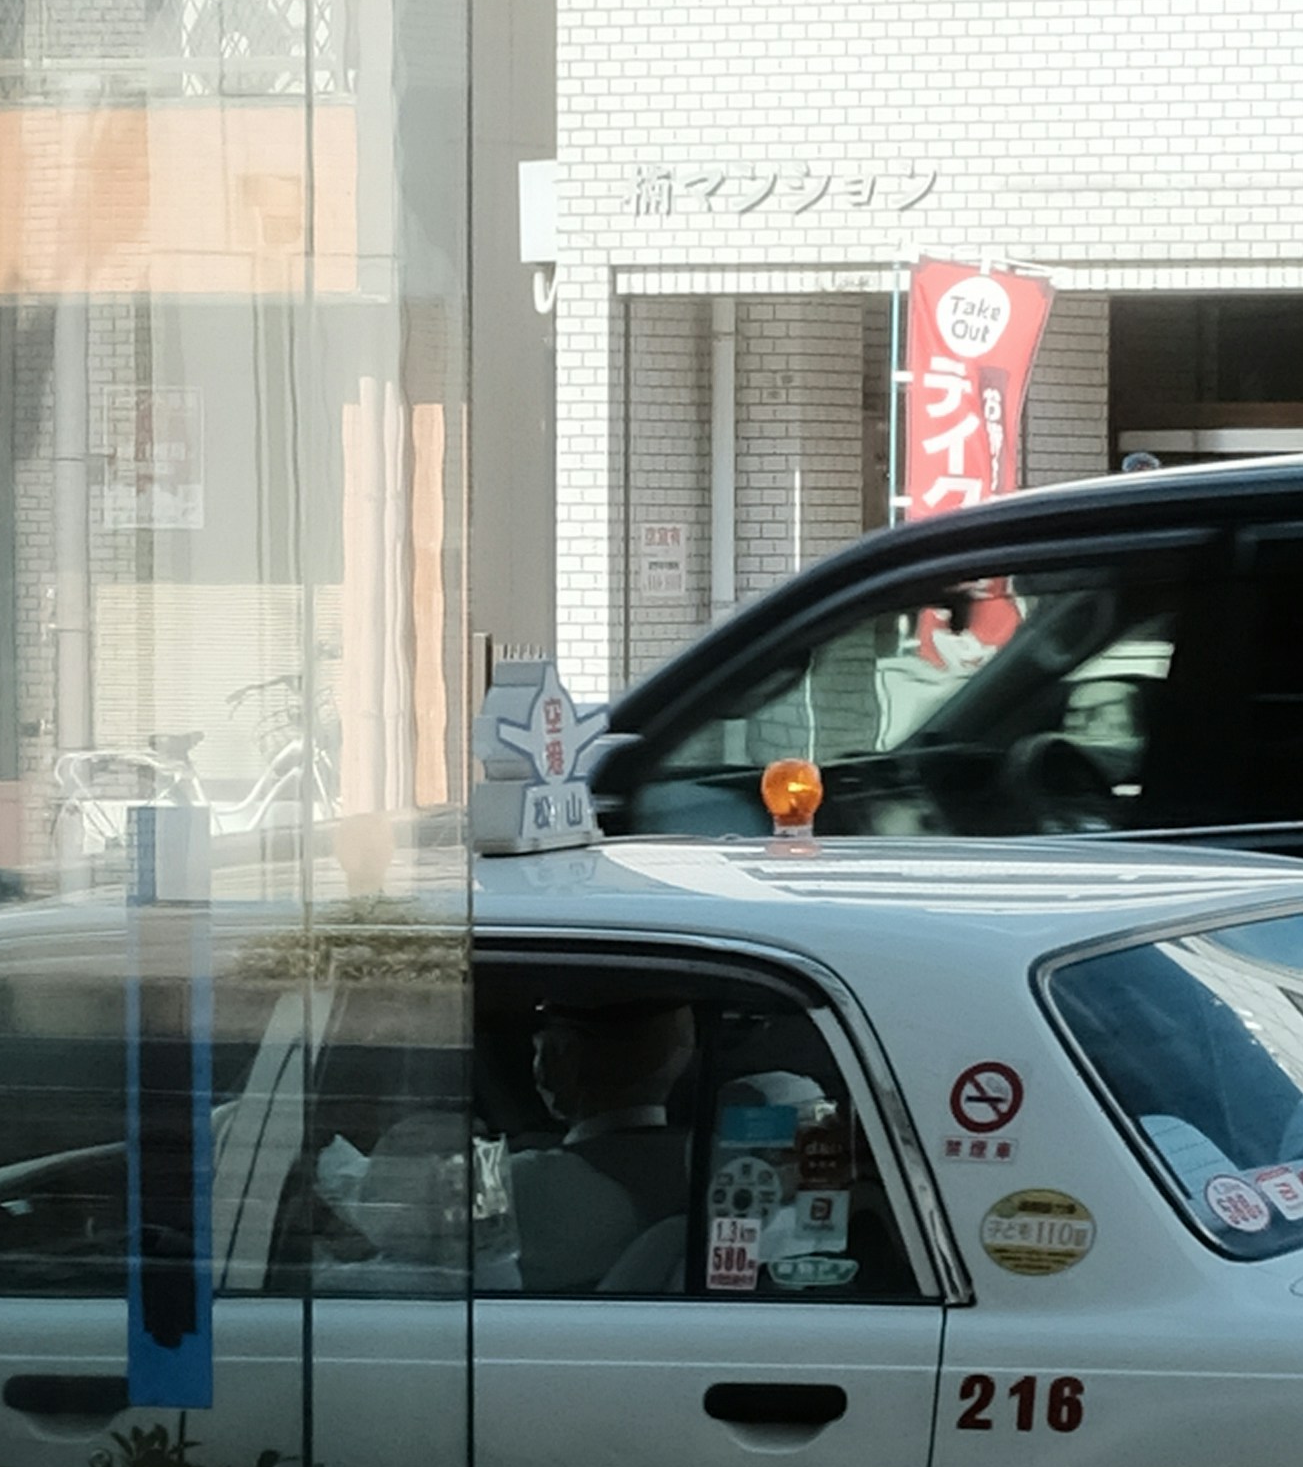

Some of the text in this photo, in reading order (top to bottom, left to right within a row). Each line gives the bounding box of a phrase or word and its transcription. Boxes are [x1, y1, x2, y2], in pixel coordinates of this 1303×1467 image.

[950, 296, 1002, 323] Take
[951, 320, 991, 344] Out
[956, 1374, 1085, 1433] 216
